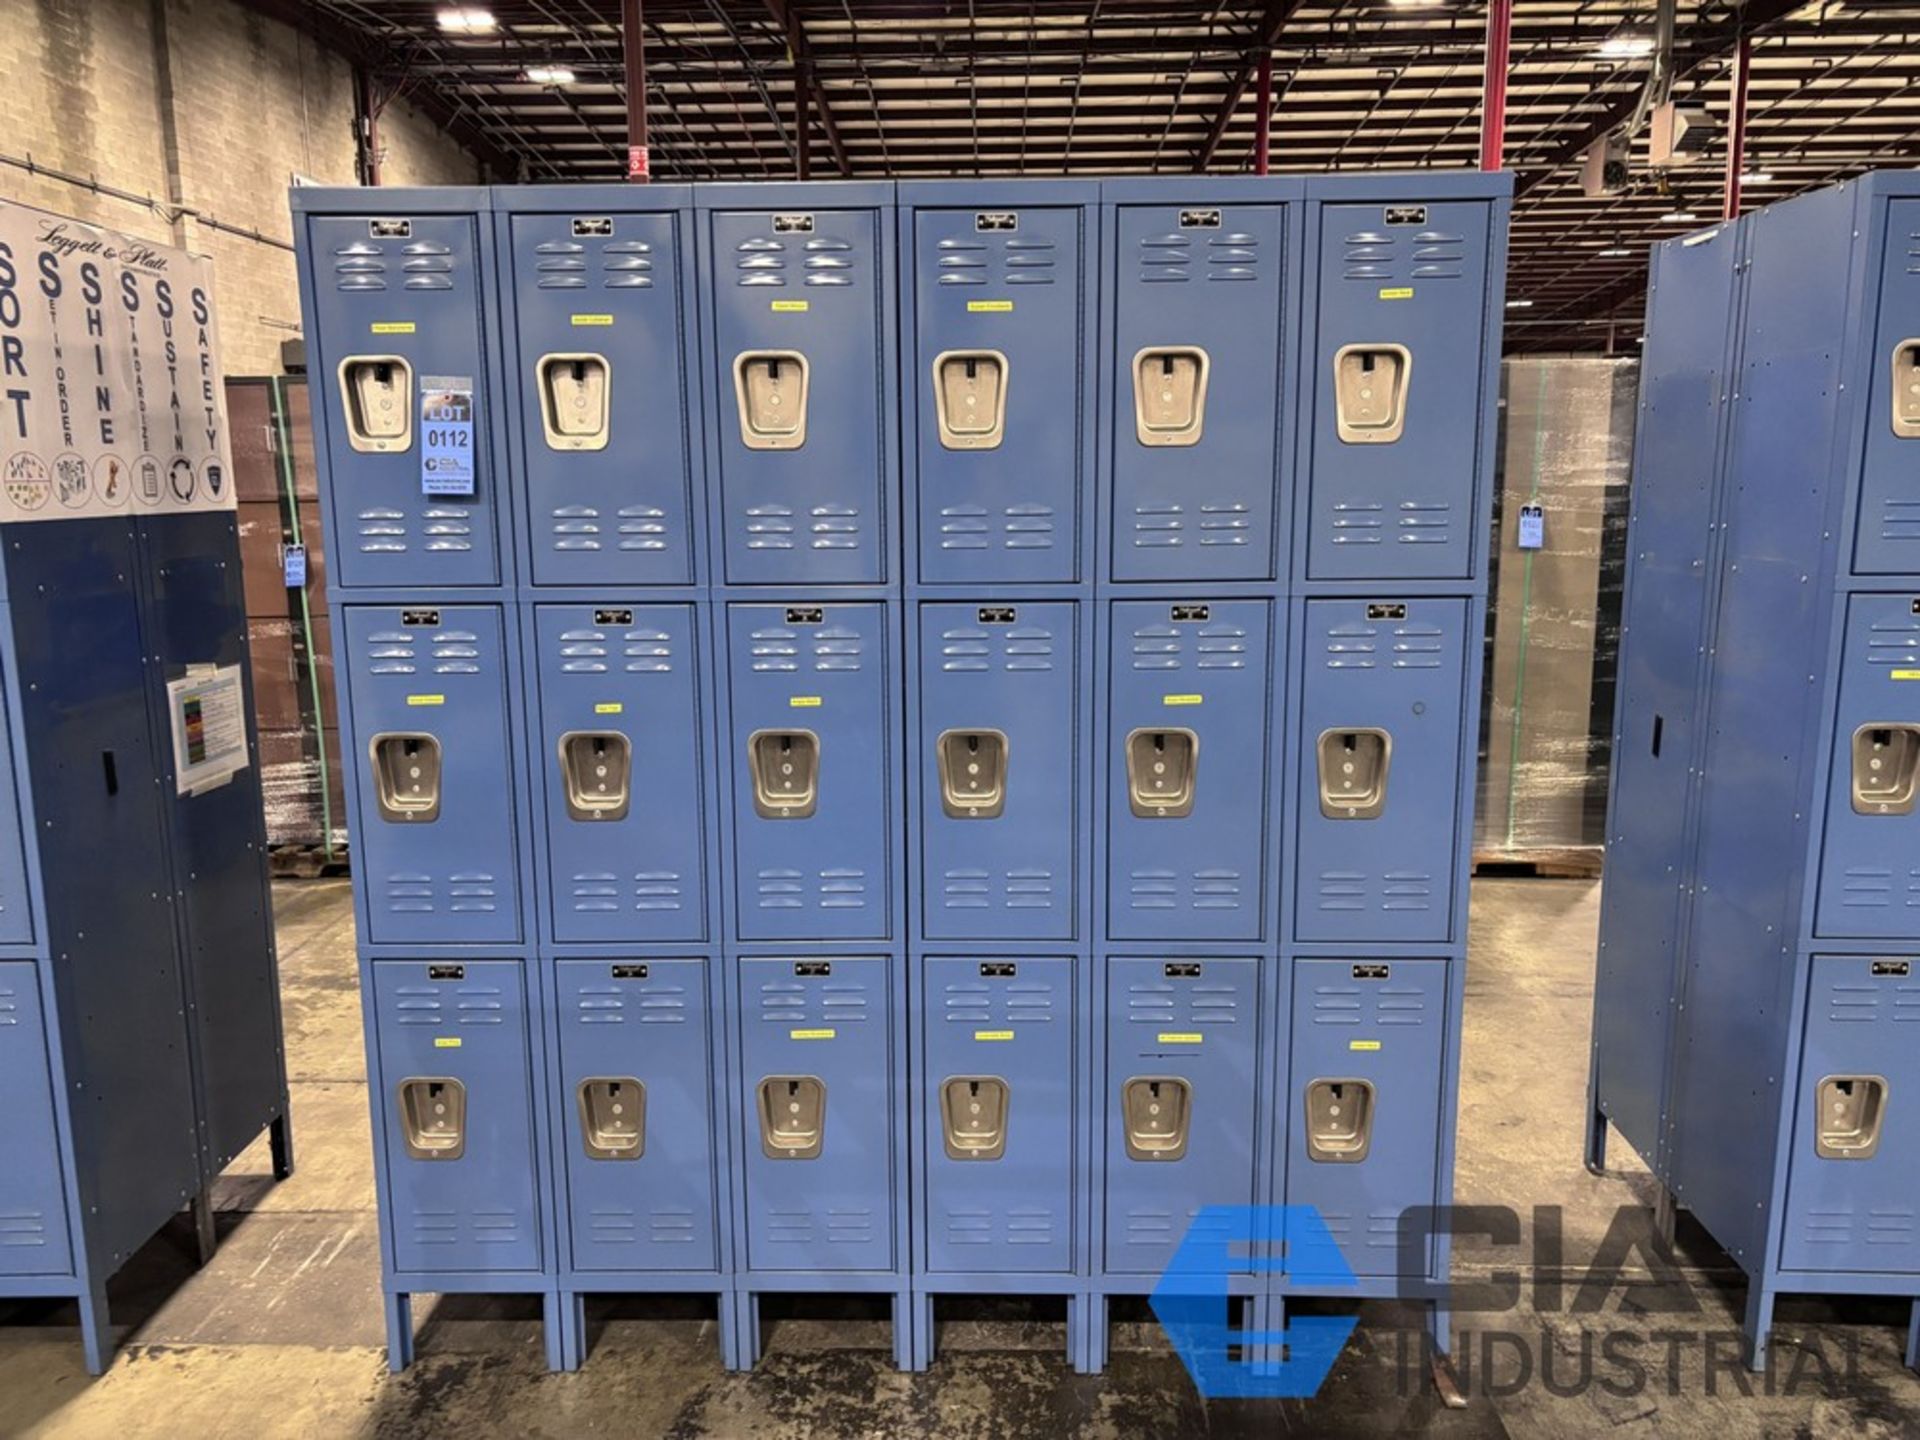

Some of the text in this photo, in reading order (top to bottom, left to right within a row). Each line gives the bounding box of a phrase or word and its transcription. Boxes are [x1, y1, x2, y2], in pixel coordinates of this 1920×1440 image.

[35, 219, 103, 257] Leggett
[103, 247, 118, 260] &
[0, 241, 30, 439] SORT
[80, 261, 115, 445] SHINE
[155, 279, 183, 452] SUSTAIN
[191, 287, 217, 451] SAFETY
[56, 367, 74, 448] ORDER
[428, 429, 468, 448] 0112
[430, 405, 465, 421] LOT
